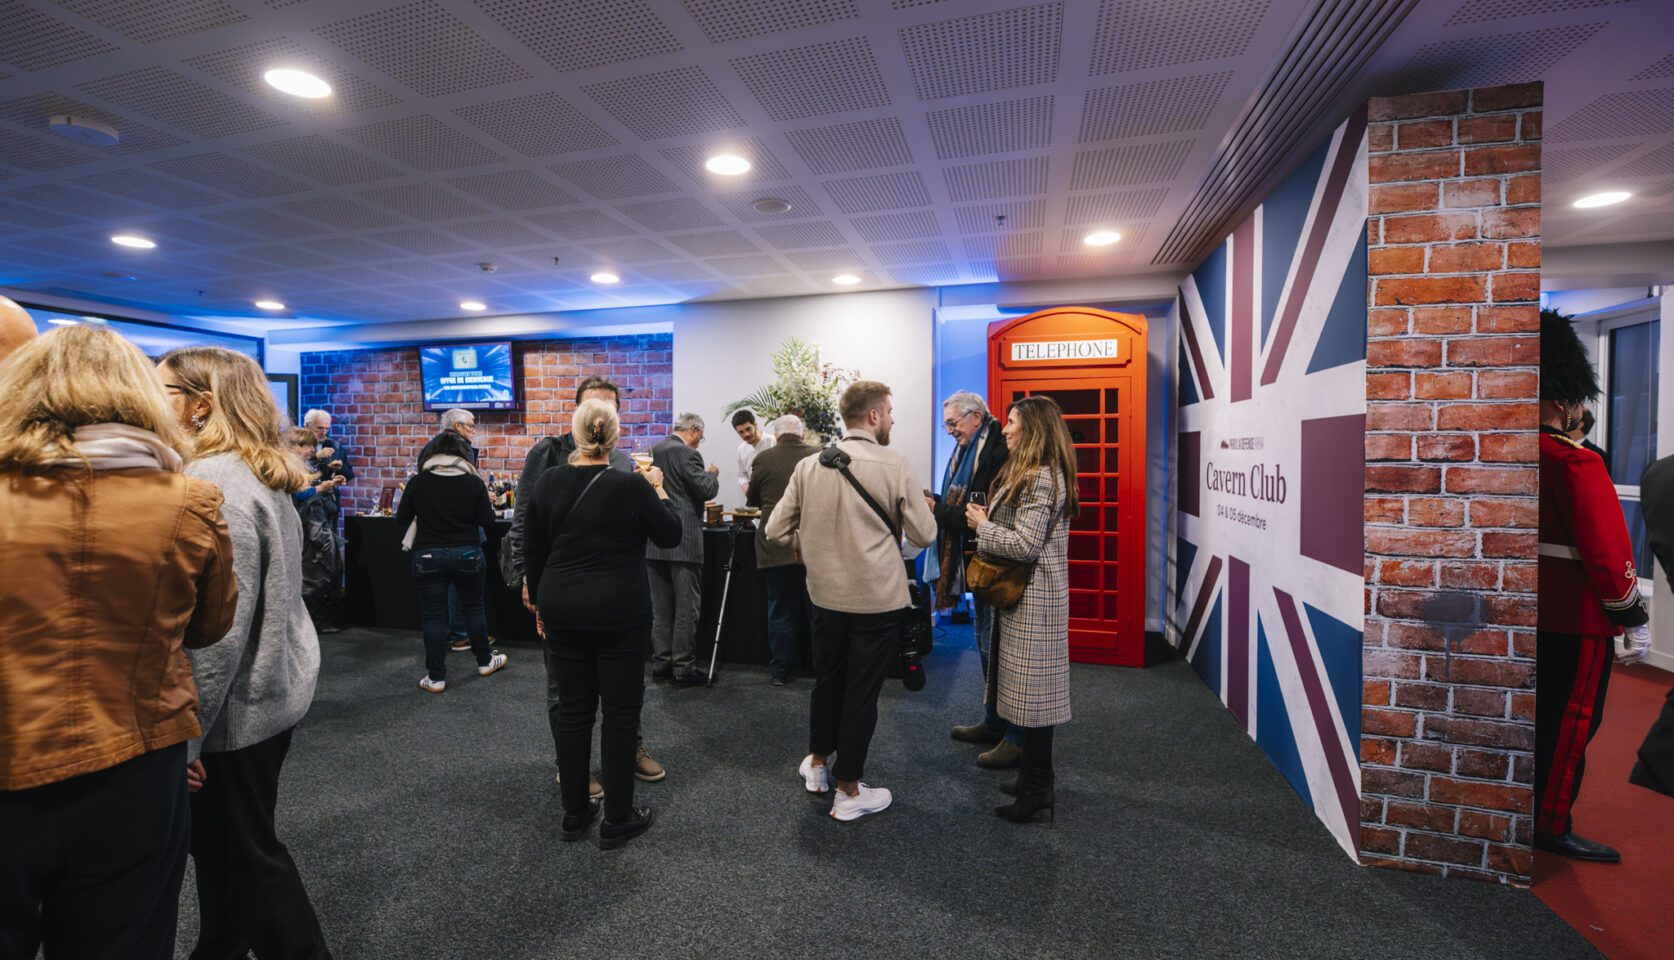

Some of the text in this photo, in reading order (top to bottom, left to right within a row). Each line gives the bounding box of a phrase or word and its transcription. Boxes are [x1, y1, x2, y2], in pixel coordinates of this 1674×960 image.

[1015, 341, 1114, 359] TELEPHONE
[1206, 461, 1286, 504] Cavern Club
[1217, 504, 1267, 531] 04 & 05 décembre
